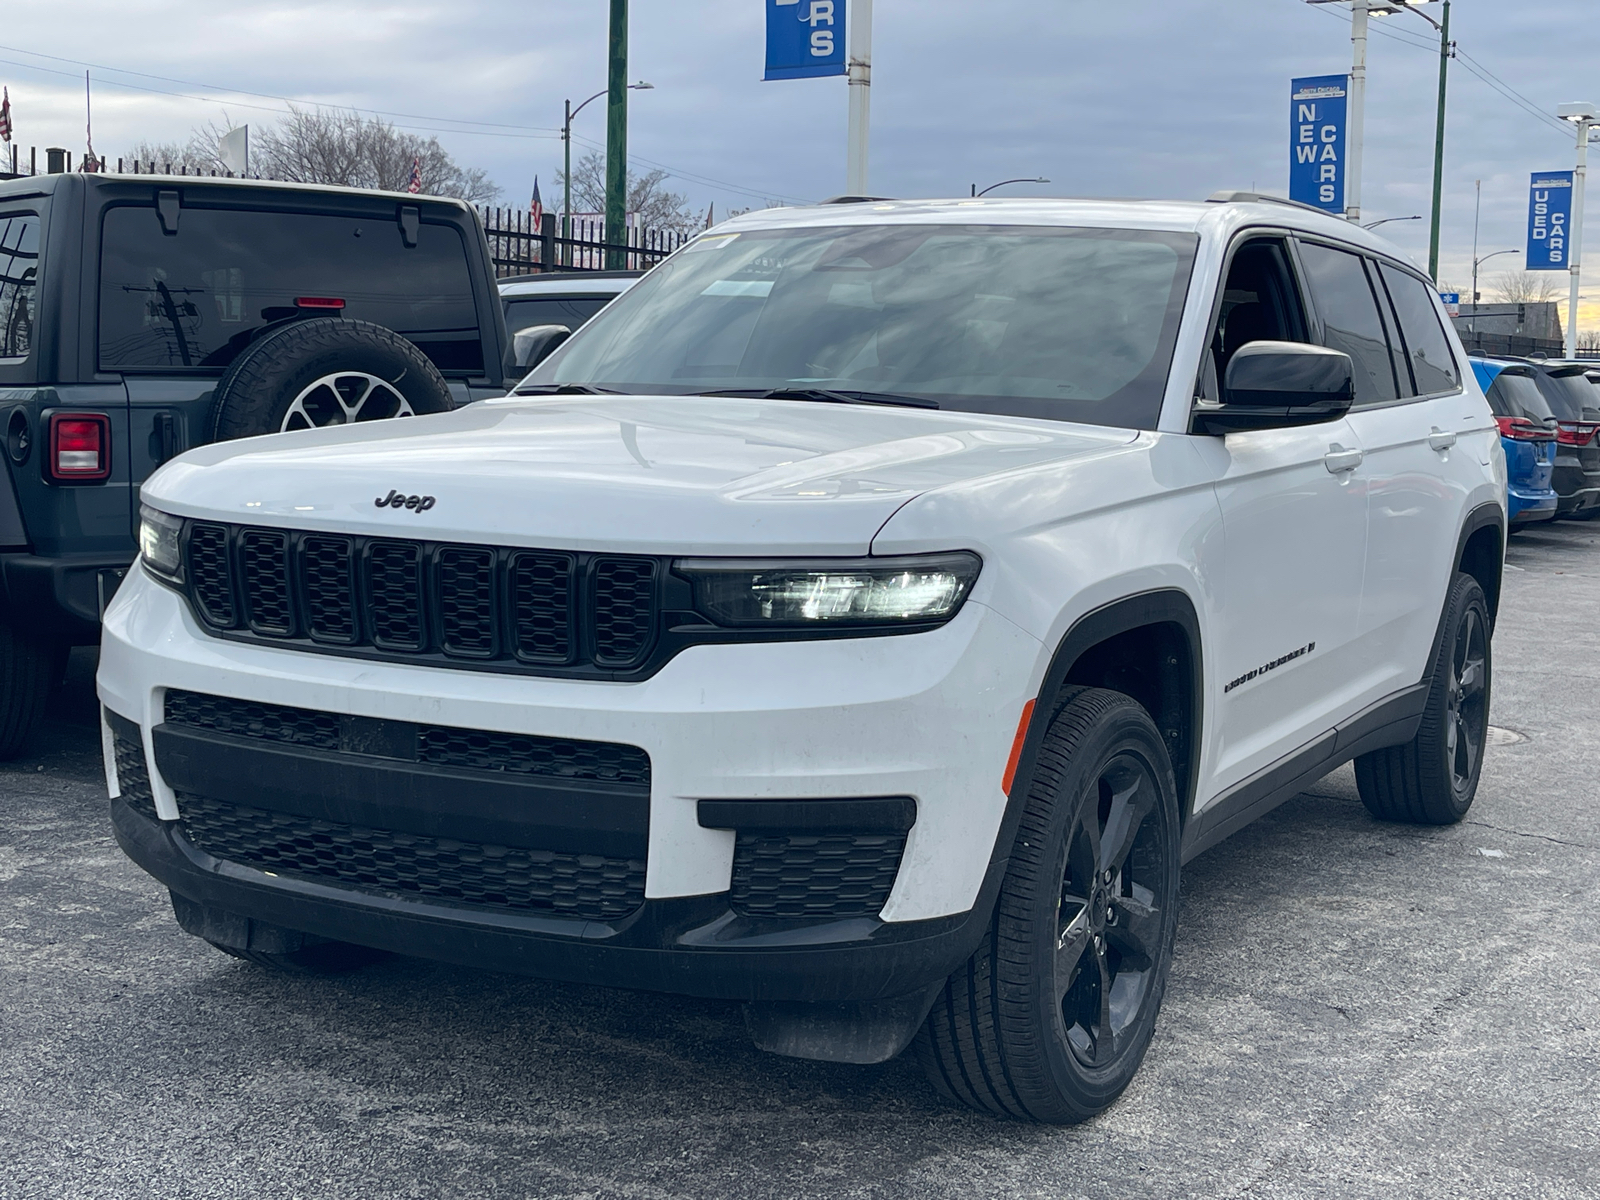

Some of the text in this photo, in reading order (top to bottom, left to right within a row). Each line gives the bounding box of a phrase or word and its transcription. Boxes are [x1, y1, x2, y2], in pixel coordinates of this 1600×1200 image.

[1296, 104, 1317, 163] NEW
[1320, 125, 1337, 202] CARS
[1532, 191, 1549, 239] USED
[1549, 213, 1565, 262] CARS
[375, 489, 435, 514] Jeep
